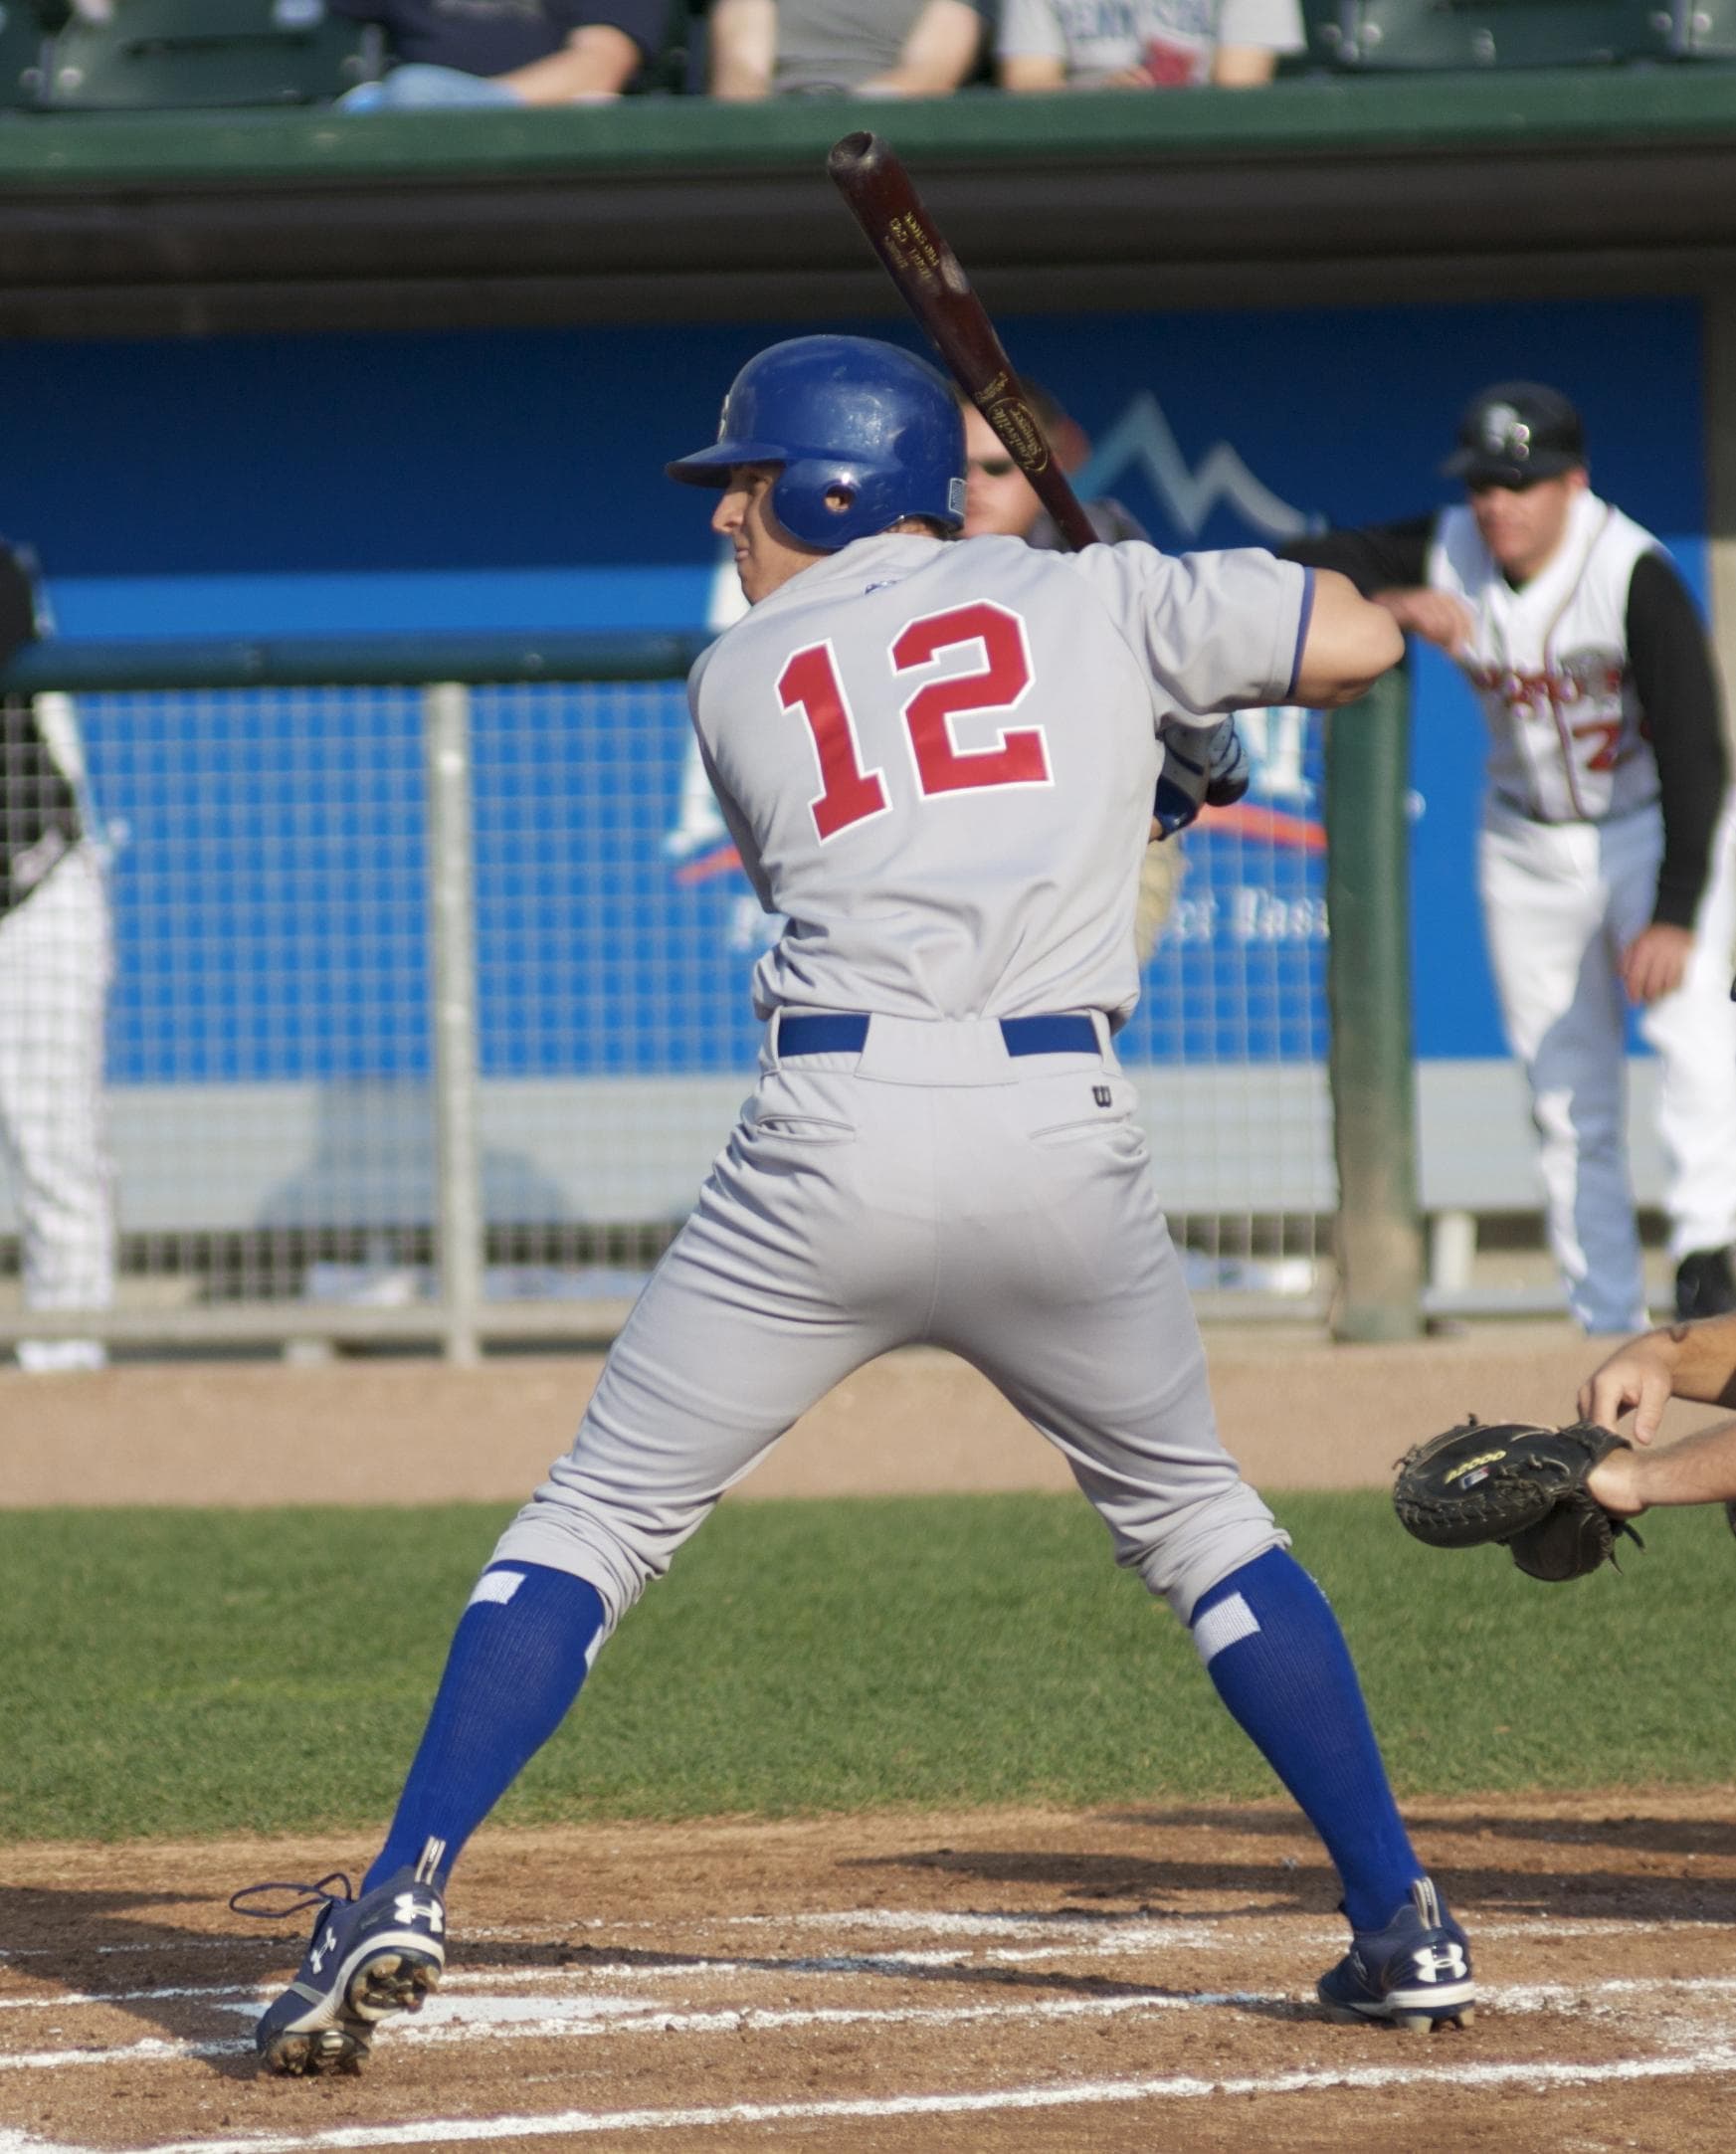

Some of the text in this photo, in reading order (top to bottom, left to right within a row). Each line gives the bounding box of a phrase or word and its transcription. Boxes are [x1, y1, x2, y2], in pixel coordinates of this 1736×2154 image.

[987, 404, 1036, 470] Louisville
[1006, 405, 1046, 457] Slugger
[774, 598, 1054, 845] 12
[1444, 1450, 1507, 1485] A2000
